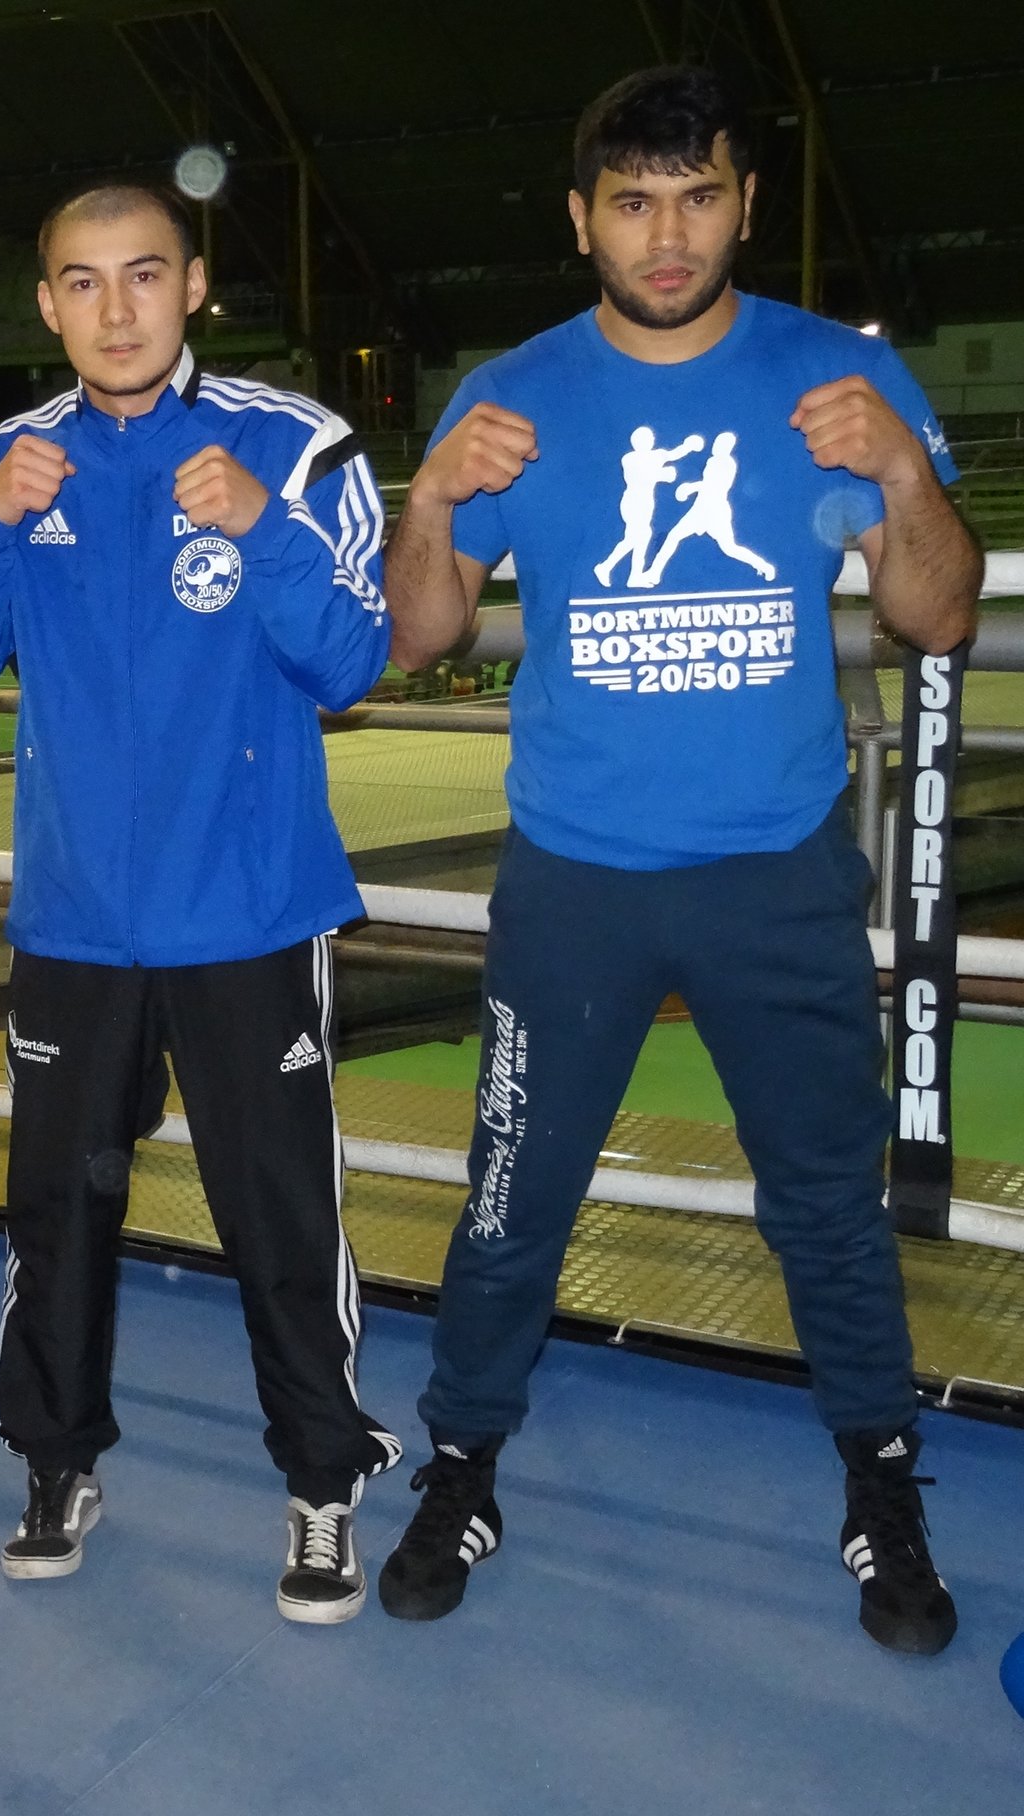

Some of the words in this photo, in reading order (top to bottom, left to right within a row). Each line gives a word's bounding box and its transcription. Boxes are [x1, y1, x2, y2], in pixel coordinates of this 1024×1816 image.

[29, 531, 76, 545] adidas
[175, 540, 239, 575] DORTMUNDER
[179, 584, 235, 611] BOXSPORT
[197, 584, 223, 599] 20/50
[569, 601, 795, 634] DORTMUNDER
[570, 626, 796, 666] BOXSPORT
[636, 662, 741, 693] 20/50
[280, 1050, 321, 1072] adidas
[515, 1050, 527, 1074] SINCE
